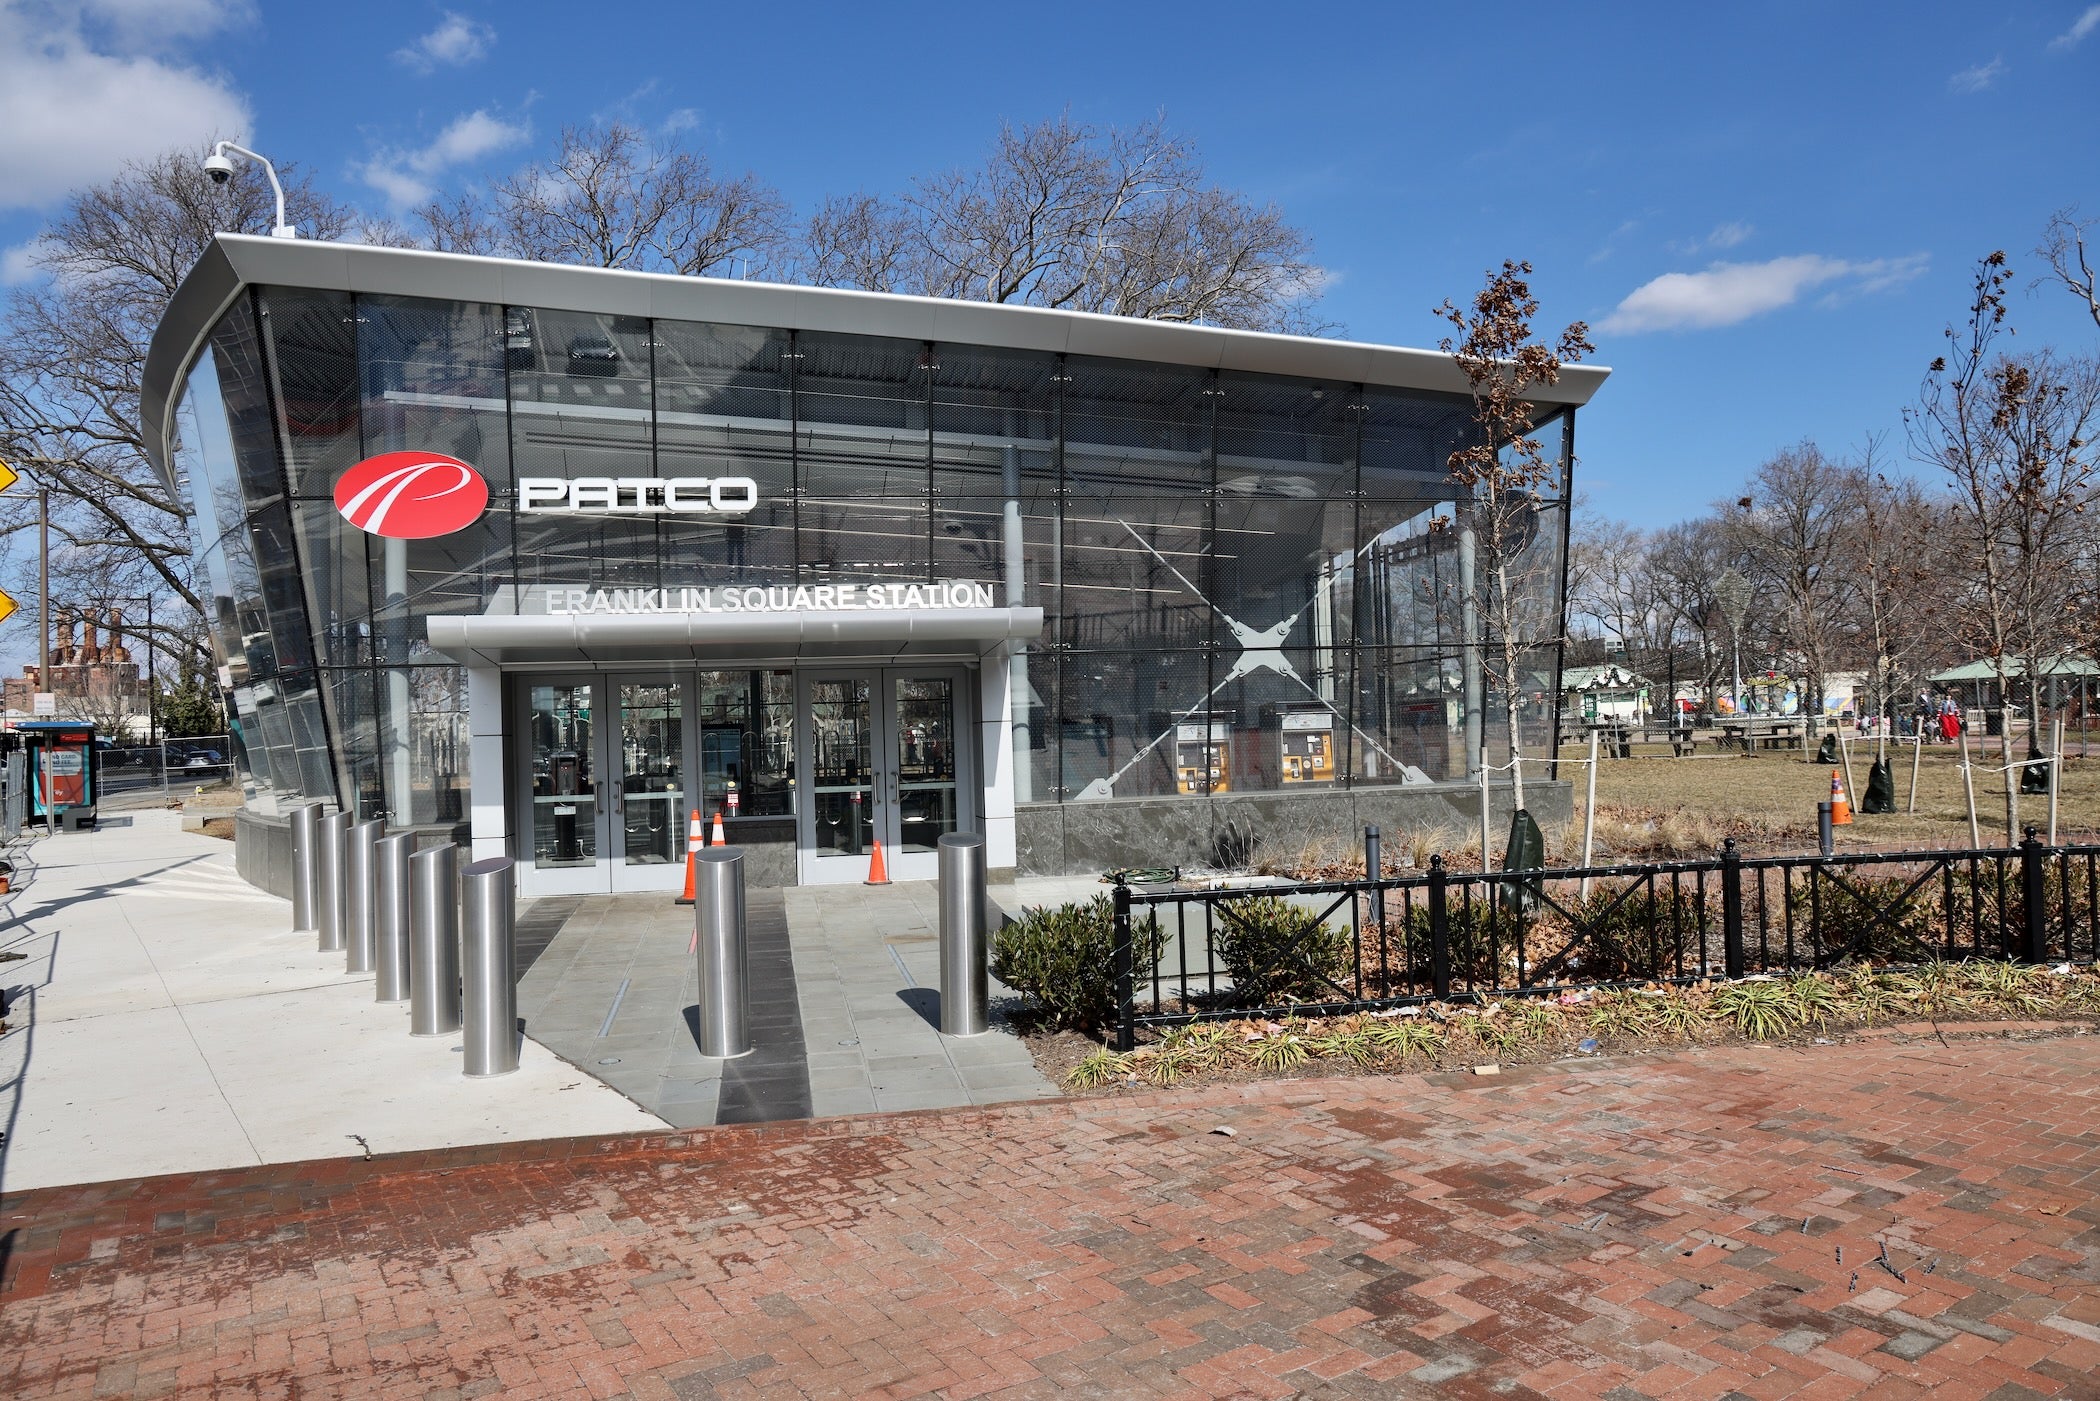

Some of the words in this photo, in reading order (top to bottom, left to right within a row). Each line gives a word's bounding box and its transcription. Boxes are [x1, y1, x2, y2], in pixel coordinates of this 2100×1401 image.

[519, 477, 758, 512] PATCO
[546, 587, 711, 614] FRANKLIN
[721, 585, 856, 613] SQUARE
[866, 583, 994, 609] STATION
